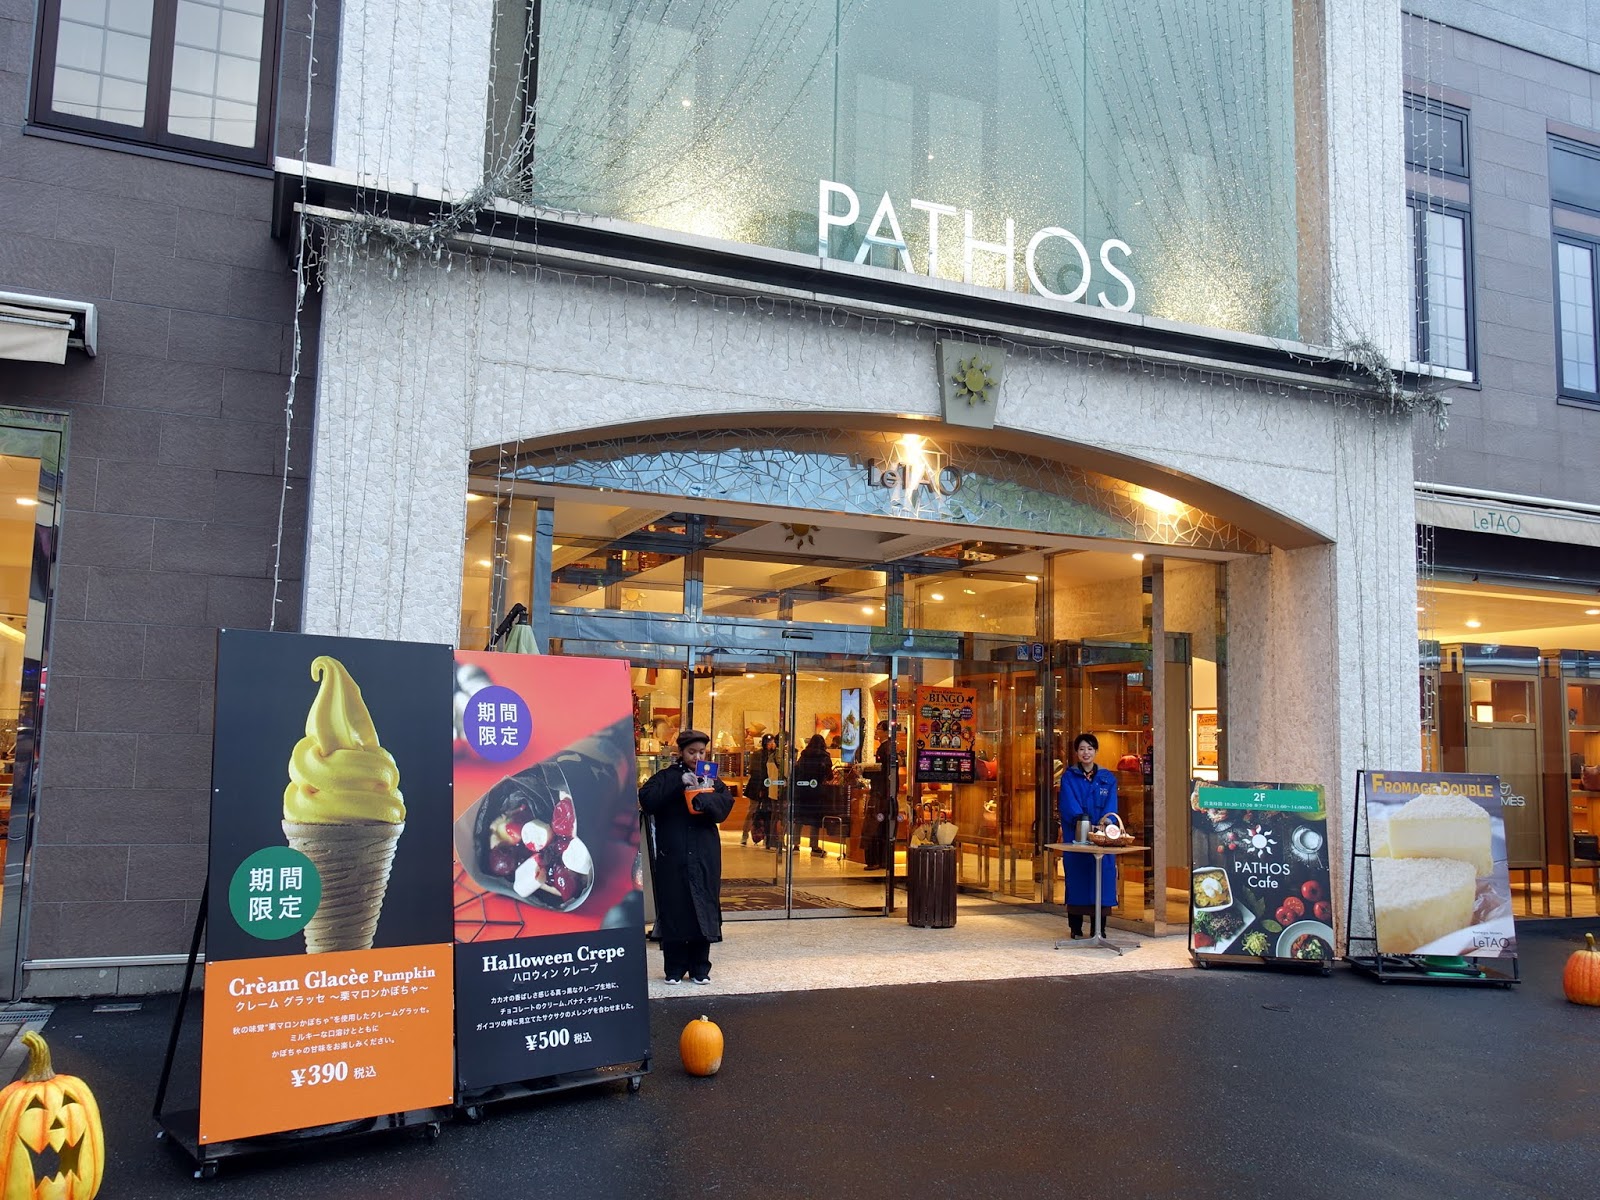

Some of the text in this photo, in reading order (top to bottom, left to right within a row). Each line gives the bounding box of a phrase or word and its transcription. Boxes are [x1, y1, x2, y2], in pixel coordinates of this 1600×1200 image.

[818, 179, 1136, 313] PATHOS
[1473, 510, 1521, 534] LeTAO
[929, 693, 965, 704] BINGO
[477, 702, 518, 723] 期間
[478, 725, 519, 746] 限定
[1371, 773, 1494, 798] FROMAGE DOUBLE
[1253, 792, 1266, 802] 2F
[248, 866, 303, 892] 期間
[1234, 861, 1291, 876] PATHOS
[1247, 875, 1279, 889] Cafe
[248, 895, 302, 922] 限定
[1472, 936, 1510, 948] LeTAO
[482, 945, 625, 972] Halloween Crepe
[228, 966, 436, 997] Crèam Glacèe Pumpkin
[512, 963, 599, 983] ハロウィン クレープ
[235, 1000, 279, 1013] クレーム
[283, 992, 326, 1007] グラッセ
[290, 1024, 379, 1042] ミルキーな口溶けとともに
[525, 1028, 593, 1051] ¥500 税込
[290, 1061, 377, 1088] ¥390 税込
